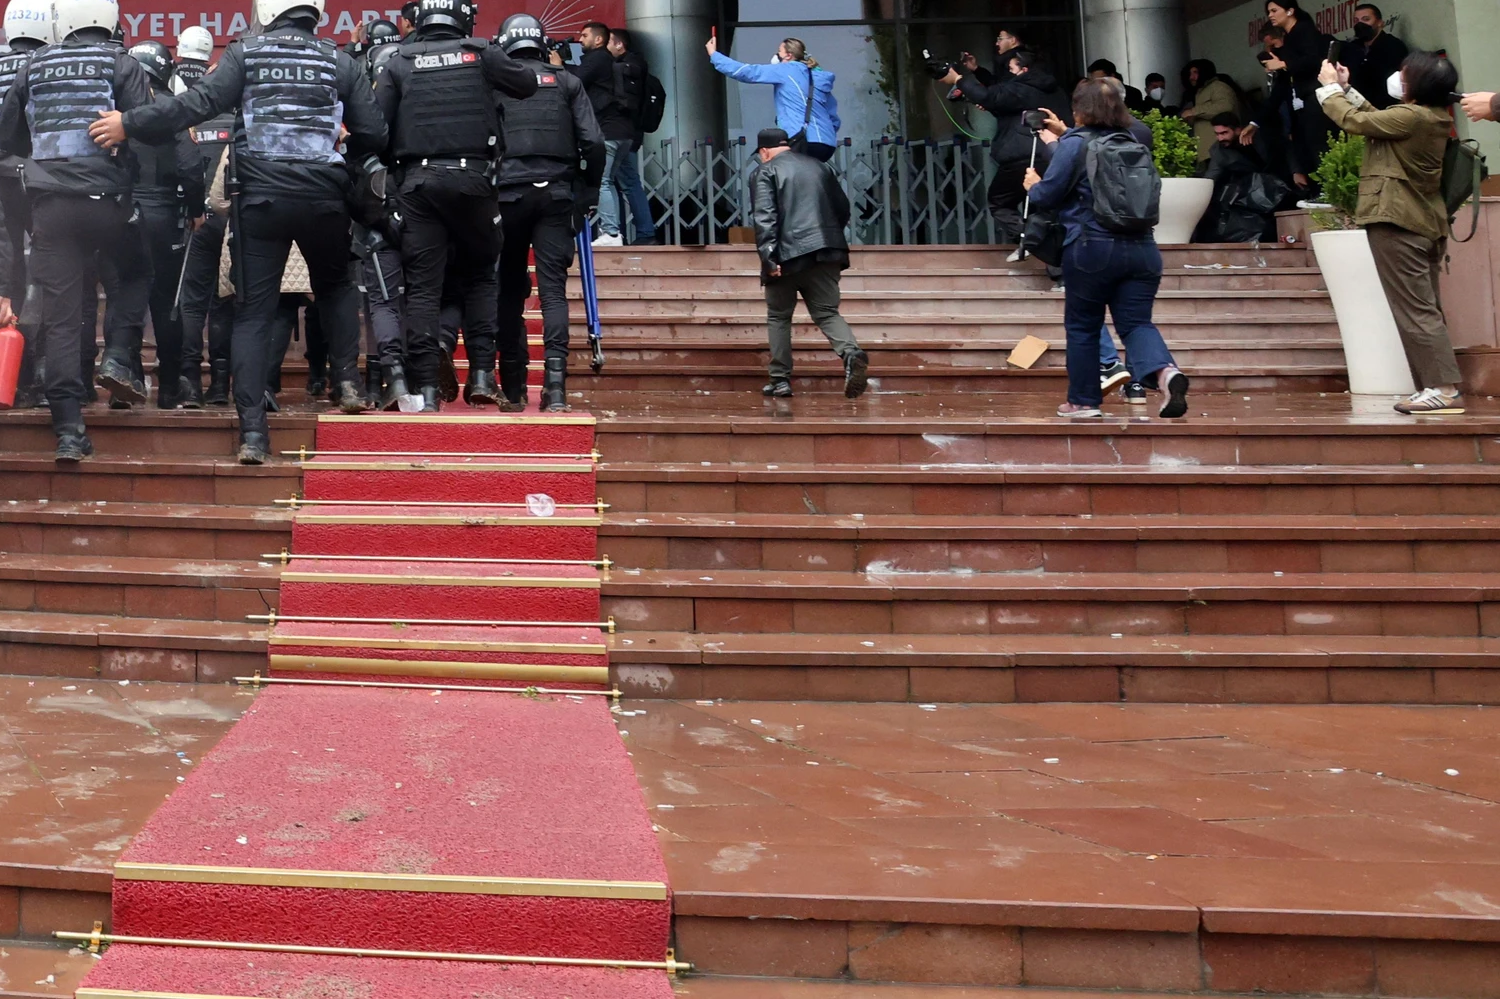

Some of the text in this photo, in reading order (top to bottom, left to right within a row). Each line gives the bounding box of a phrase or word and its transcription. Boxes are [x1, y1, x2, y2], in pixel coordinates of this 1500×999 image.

[423, 0, 454, 10] T1101
[44, 62, 96, 79] POLİS
[258, 67, 316, 81] POLİS
